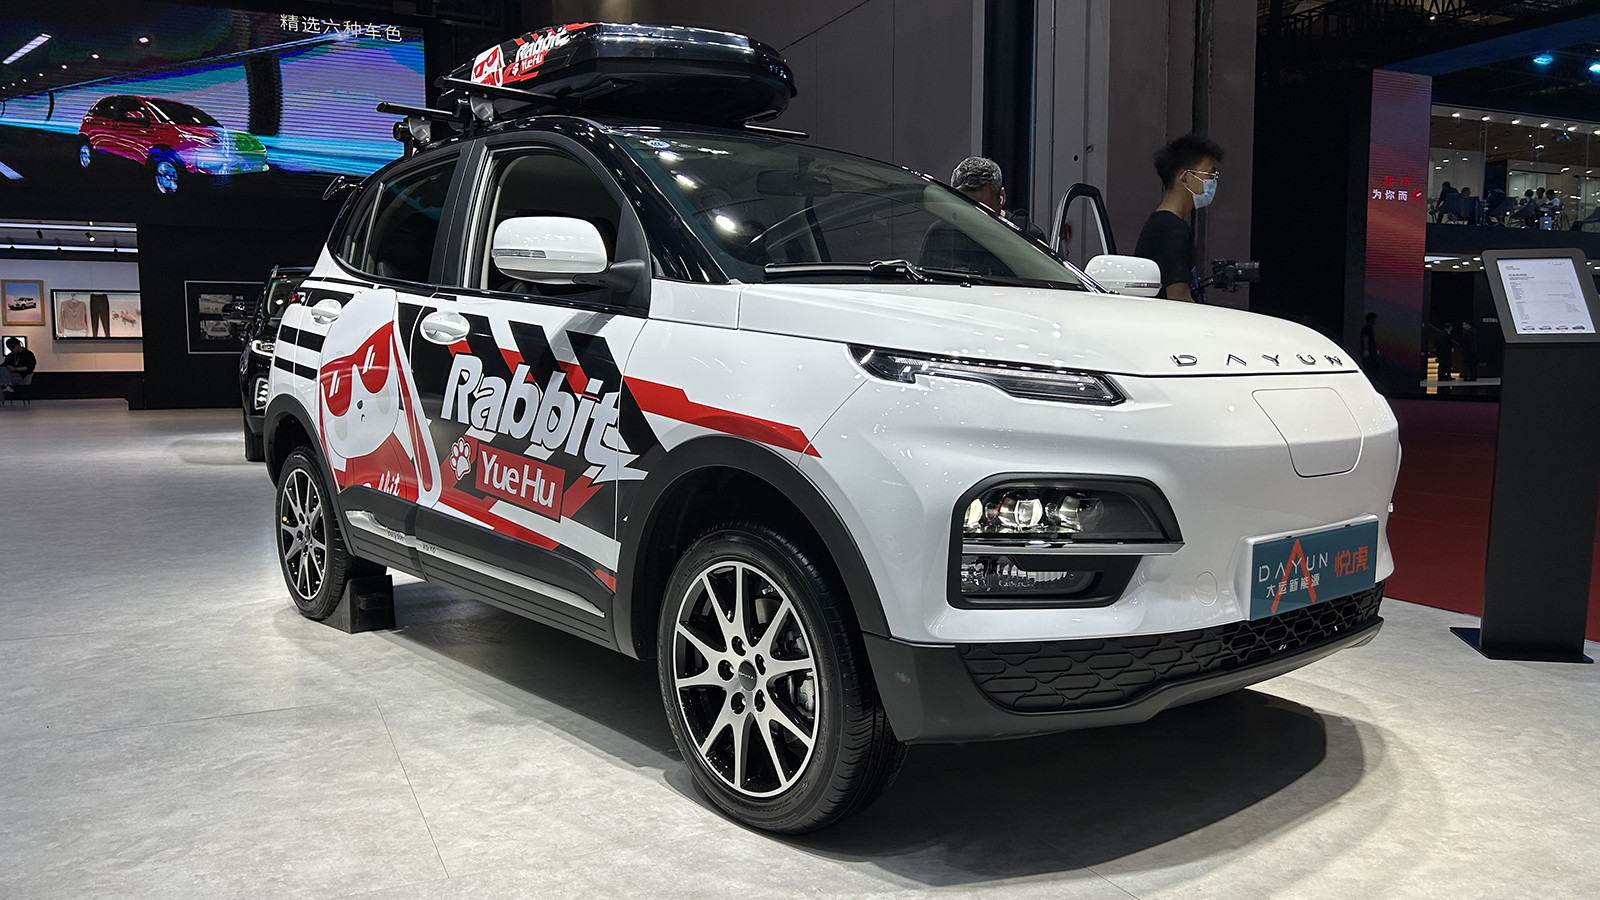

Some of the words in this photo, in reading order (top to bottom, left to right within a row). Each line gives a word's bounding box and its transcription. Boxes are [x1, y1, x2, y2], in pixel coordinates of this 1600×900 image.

[280, 14, 402, 42] 精选六种车色
[1170, 353, 1343, 367] DAYUN
[440, 353, 649, 484] Rabbit
[1258, 552, 1328, 582] DAYUN
[1334, 546, 1369, 578] 悦虎
[1266, 573, 1320, 598] 大运新能源
